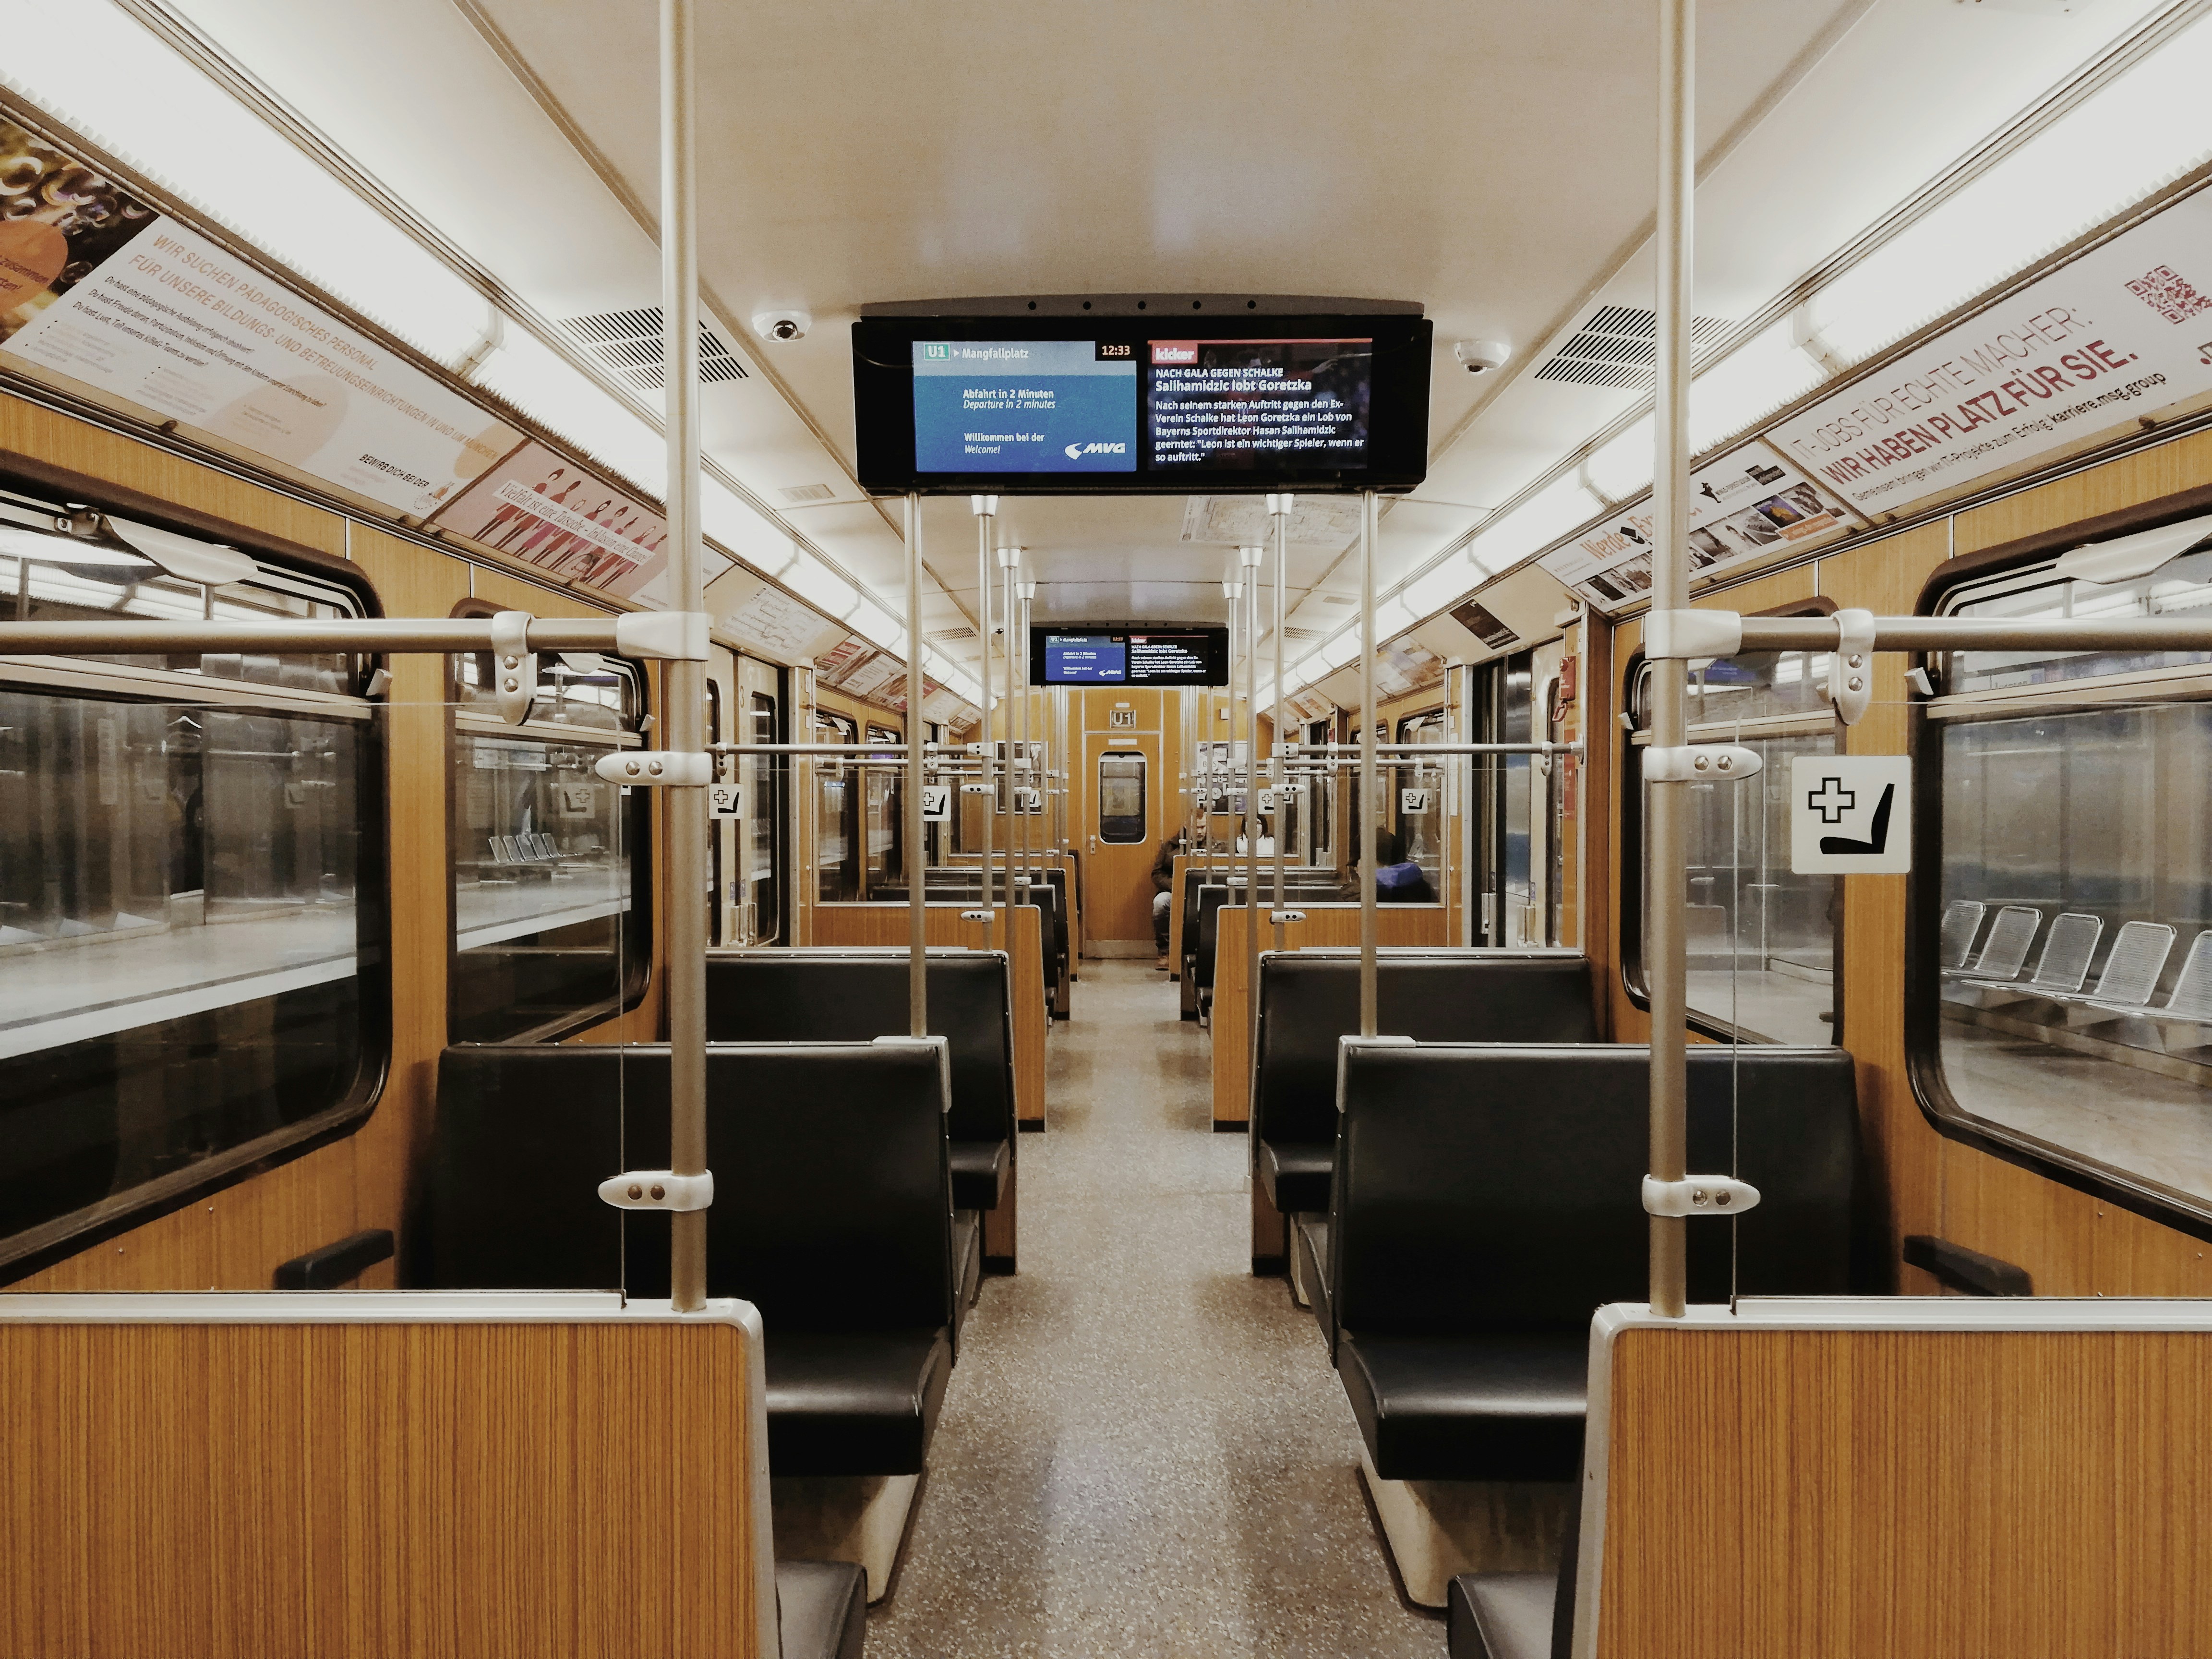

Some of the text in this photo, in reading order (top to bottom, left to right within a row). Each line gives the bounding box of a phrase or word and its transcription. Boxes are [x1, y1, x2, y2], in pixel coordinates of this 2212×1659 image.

[105, 276, 115, 284] Du
[88, 289, 99, 297] Du
[73, 301, 84, 310] Du
[153, 234, 378, 370] WIR SUCHEN PÄDAGOGISCHES PERSONAL
[128, 254, 162, 276] FÜR
[159, 270, 216, 305] UNSERE
[211, 300, 275, 337] BILDUNGS-
[275, 334, 302, 352] UND
[298, 348, 429, 422] BETREUUNGSEINRICHTUNGEN
[425, 417, 439, 427] IN
[435, 422, 455, 435] UND
[451, 432, 467, 443] UM
[928, 346, 1029, 361] U1 Mangfallplatz
[1103, 346, 1130, 355] 12:33
[1156, 348, 1194, 360] kicker
[1156, 367, 1283, 378] NACH GALA GEGEN SCHALKE
[1156, 379, 1311, 391] Salihamidzic lobt Goretzka
[1790, 307, 2093, 460] IT-JOBS FÜR ECHTE MACHER:
[963, 389, 1054, 399] Abfahrt in 2 Minuten
[963, 398, 1056, 410] Departure in 2 minutes
[1156, 399, 1343, 410] Nach seinem starken Auftritt gegen den Ex-
[1992, 429, 2017, 447] zum
[2050, 373, 2166, 424] karriere.msg.group
[1154, 414, 1183, 423] Verein
[1186, 413, 1219, 422] Schalke
[1221, 413, 1236, 422] hat
[1237, 412, 1258, 423] Leon
[1261, 412, 1300, 422] Goretzka
[1302, 412, 1315, 421] ein
[1318, 412, 1334, 421] Lob
[1819, 457, 1871, 485] WIR
[1856, 424, 1942, 470] HABEN
[1927, 390, 2018, 439] PLATZ
[2000, 366, 2076, 407] FÜR
[2060, 339, 2139, 380] SIE.
[964, 433, 1045, 442] Willkommen bei der
[1154, 425, 1335, 438] Bayerns Sportdirektor Hasan Salihamidzic
[965, 445, 1000, 454] Welcome!
[1082, 443, 1125, 453] MVG
[1155, 440, 1195, 451] geerntet:
[1197, 440, 1222, 448] "Leon
[1225, 439, 1236, 448] ist
[1237, 439, 1250, 448] ein
[1251, 439, 1293, 450] wichtiger
[1294, 438, 1326, 449] Spieler,
[1167, 452, 1205, 461] auftritt."
[359, 454, 389, 470] BEWIRB
[385, 466, 407, 478] DICH
[402, 473, 417, 482] BEI
[412, 478, 429, 488] DER
[500, 483, 532, 505] Vielfalt
[527, 498, 542, 511] ist
[539, 505, 557, 518] eine
[554, 511, 585, 531] Tatsache
[587, 528, 617, 547] Inklusion
[613, 543, 629, 554] eine
[1579, 530, 1631, 560] Werde
[1113, 712, 1131, 725] U1
